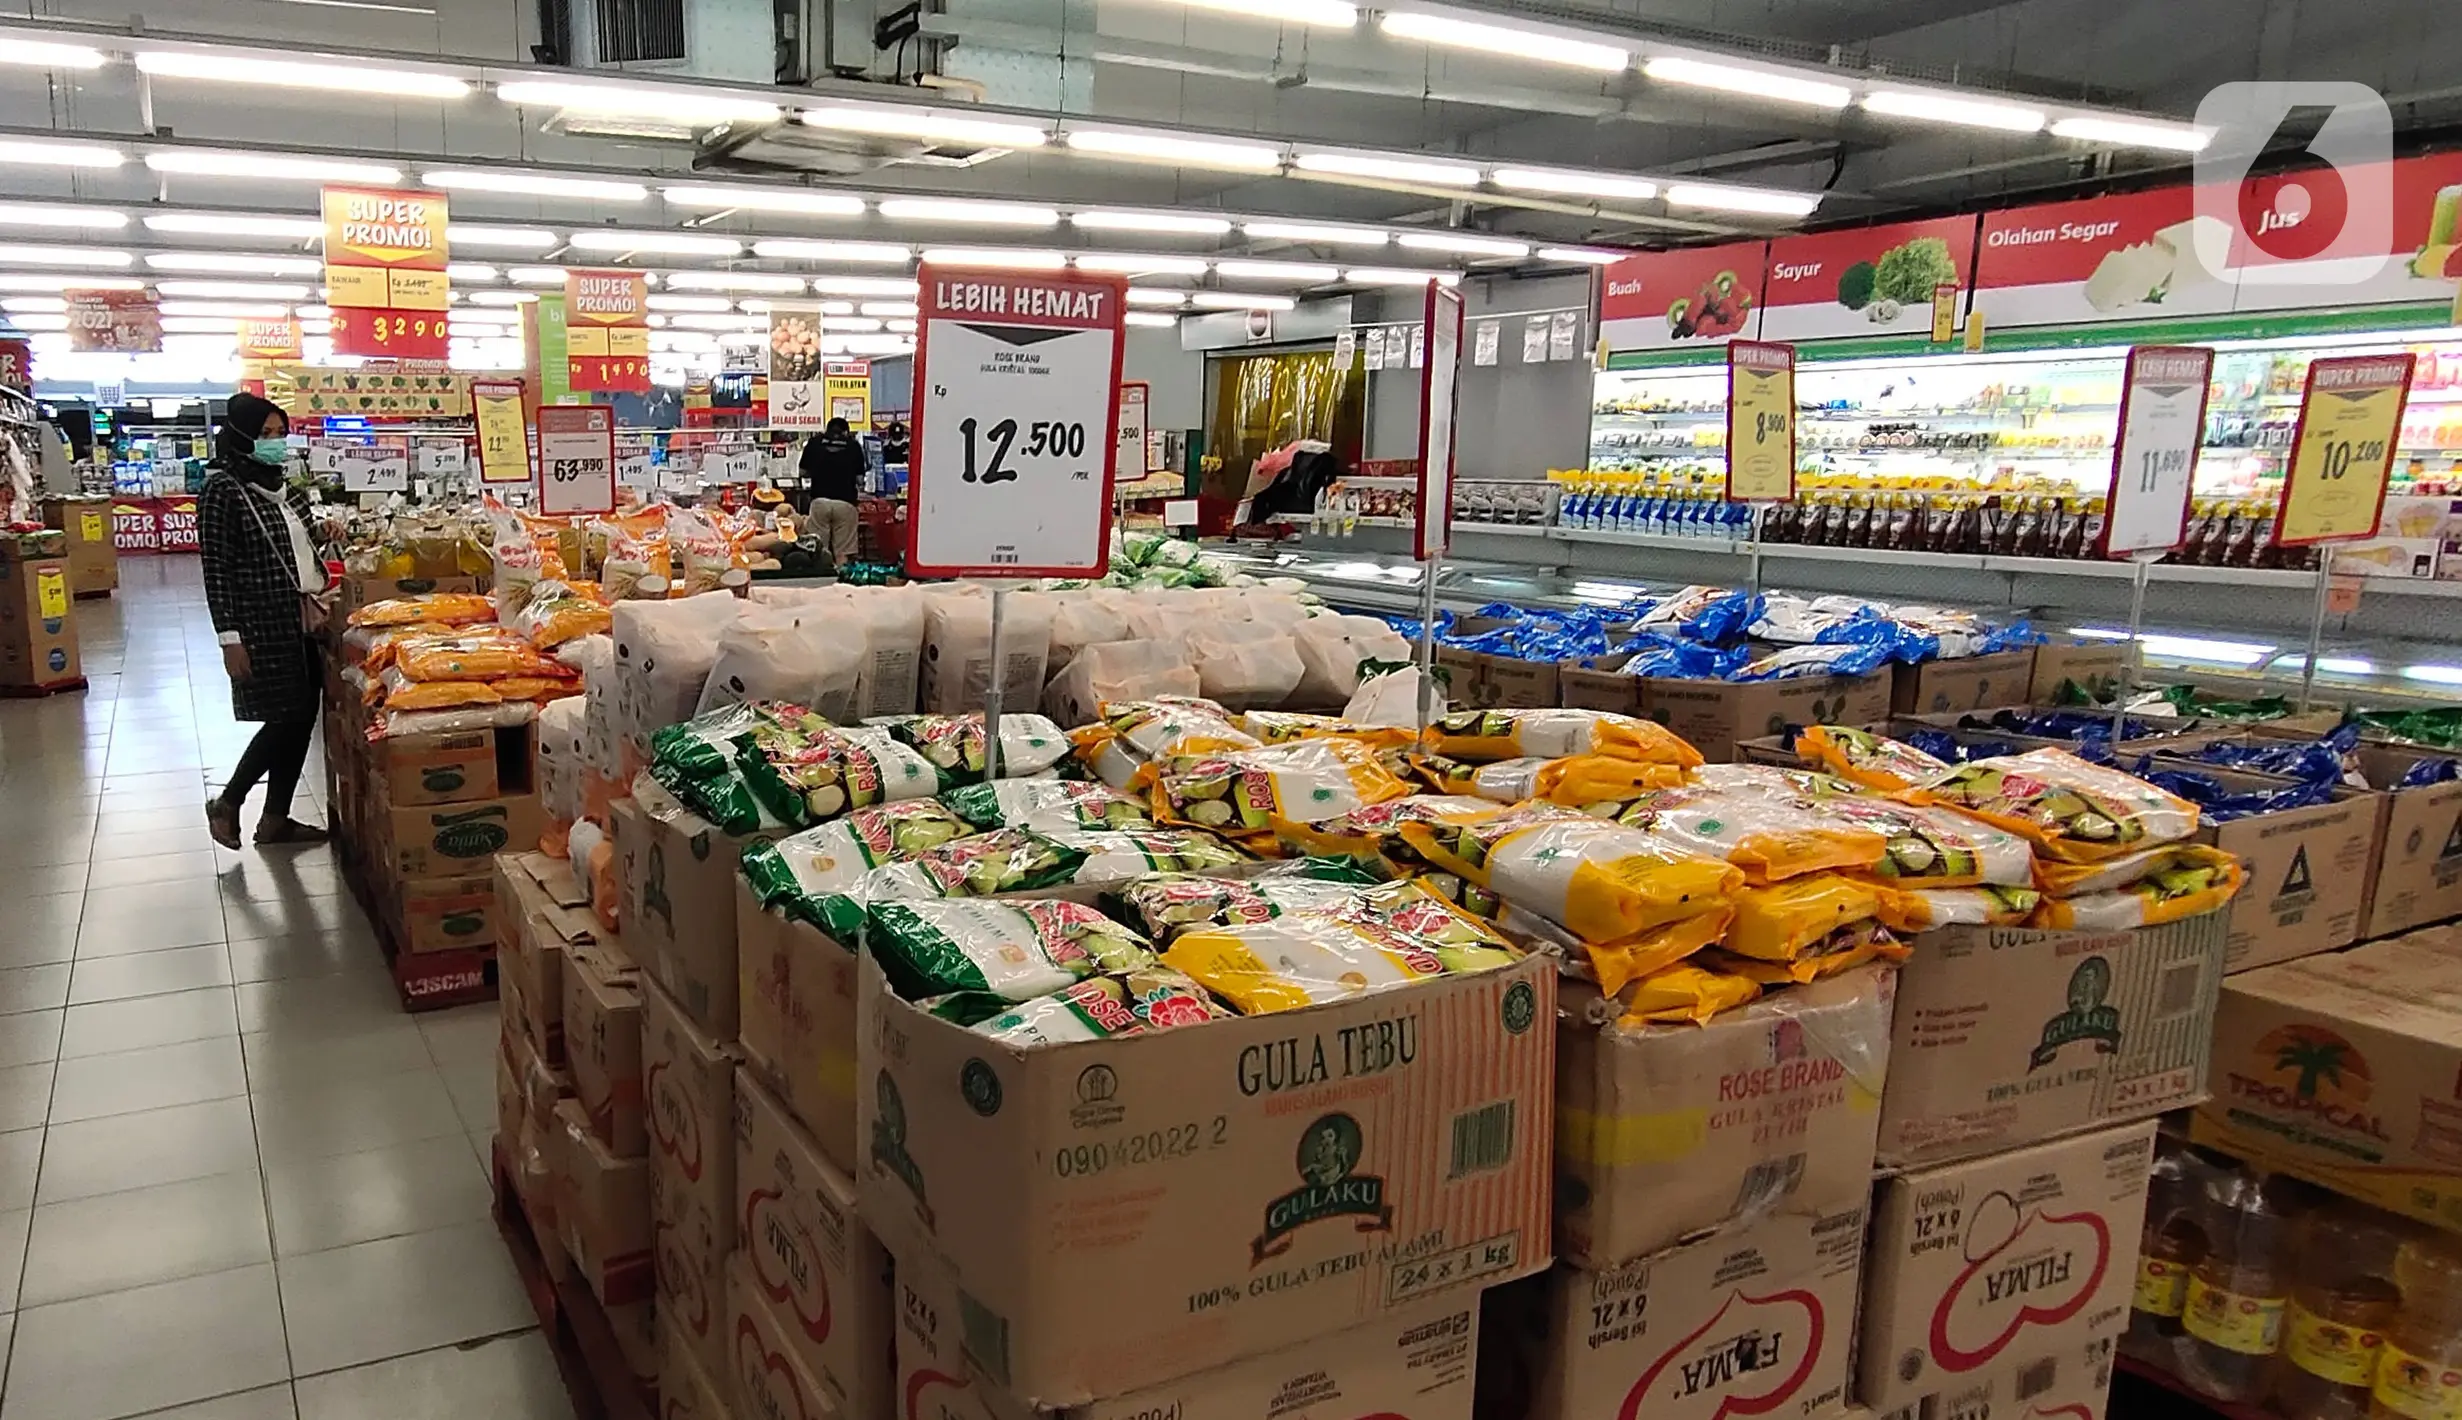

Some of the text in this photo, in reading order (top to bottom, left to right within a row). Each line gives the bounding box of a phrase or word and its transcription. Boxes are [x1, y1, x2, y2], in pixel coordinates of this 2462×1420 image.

[349, 199, 427, 226] SUPER
[2258, 209, 2300, 236] Jus
[342, 222, 433, 250] PROMO!
[1988, 221, 2119, 247] Olahan Segar
[1774, 262, 1822, 282] Sayur
[579, 277, 633, 296] SUPER
[1608, 281, 1641, 296] Buah
[576, 295, 637, 313] PROMO!
[935, 281, 1104, 320] LEBIH HEMAT
[70, 310, 114, 330] 2021
[249, 321, 292, 336] SUPER
[331, 316, 447, 347] Rp 3.290
[247, 334, 295, 348] PROMO!
[2316, 368, 2354, 386] SUPER
[934, 385, 947, 399] Rp
[1117, 427, 1139, 441] .500
[959, 416, 1085, 485] 12.500
[554, 458, 604, 483] 63.990
[112, 513, 198, 534] PER SUP
[114, 529, 199, 548] OMO! PRO
[1243, 770, 1274, 810] ROS
[1237, 1033, 1330, 1097] GULA
[1337, 1014, 1419, 1077] TEBU
[1718, 1057, 1845, 1102] ROSE BRAND
[1709, 1107, 1763, 1130] GULA
[2227, 1071, 2391, 1143] TROPICAL
[1212, 1115, 1229, 1146] 2
[1269, 1179, 1380, 1230] GULAKU
[1400, 1241, 1511, 1289] 24 x 1 kg
[1985, 1251, 2073, 1302] FILMA
[1186, 1286, 1241, 1314] 100%
[1248, 1272, 1313, 1296] GULA
[1314, 1250, 1374, 1280] TEBU
[1592, 1267, 1650, 1301] (Pouch)
[1592, 1293, 1648, 1330] 6 x 2L
[1588, 1327, 1629, 1351] Bersih
[1680, 1331, 1783, 1397] FIMA
